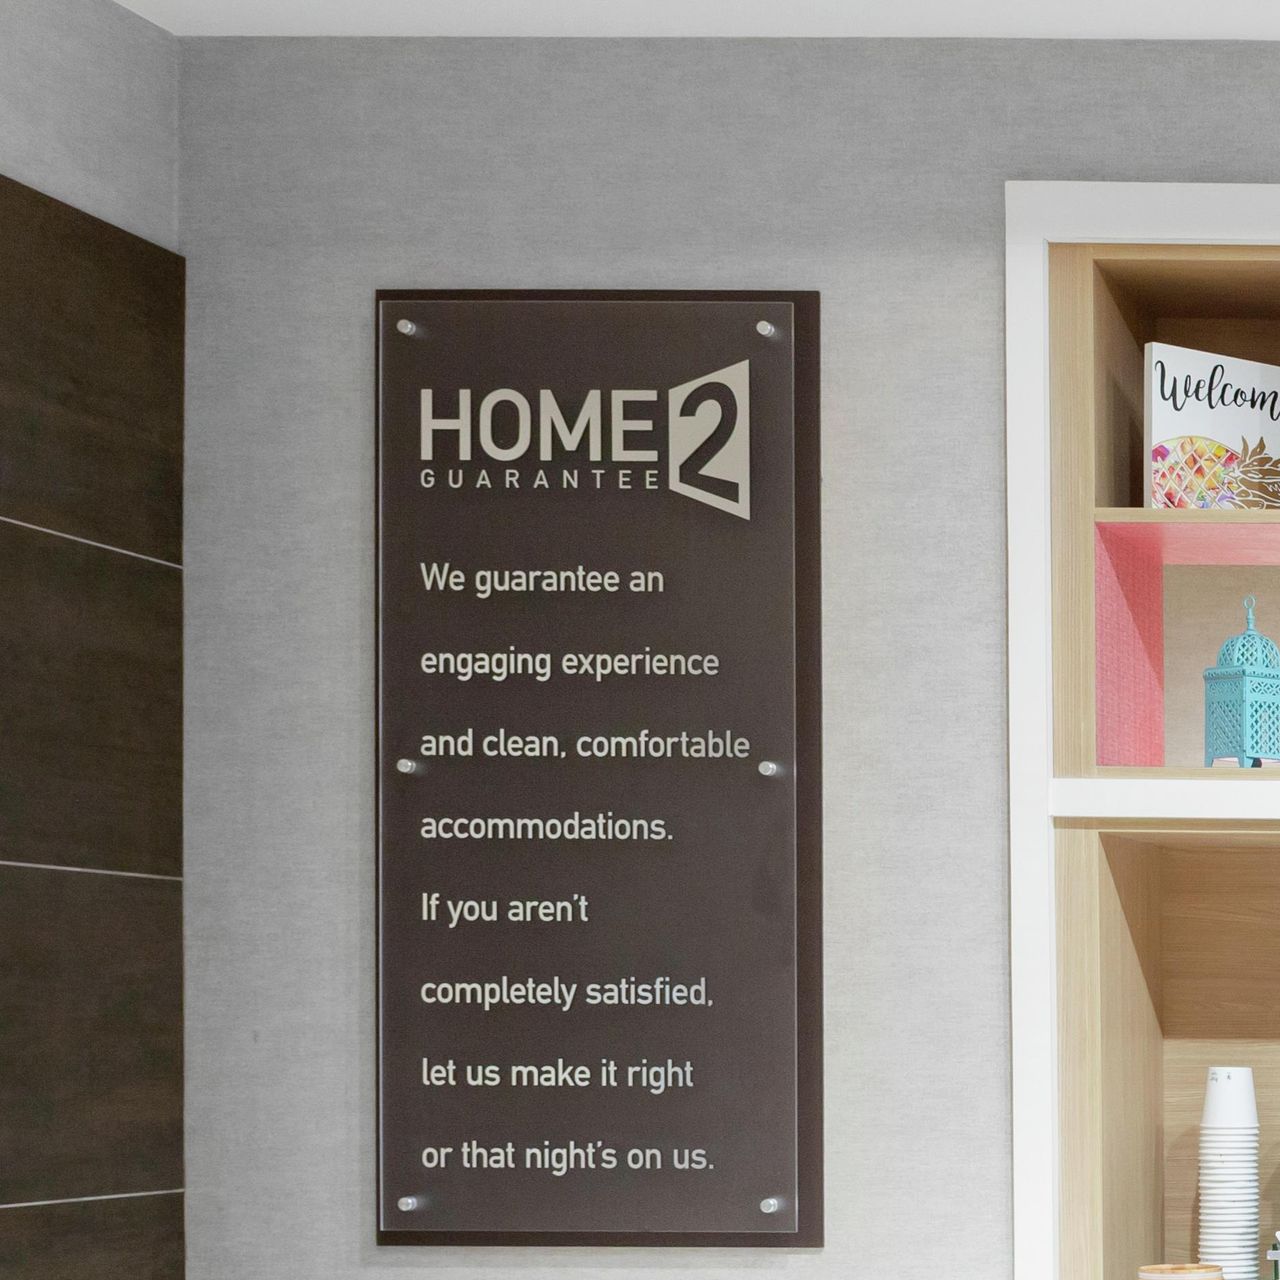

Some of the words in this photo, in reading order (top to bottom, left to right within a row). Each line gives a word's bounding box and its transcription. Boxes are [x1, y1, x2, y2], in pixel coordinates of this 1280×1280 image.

[420, 469, 659, 489] GUARANTEE
[420, 562, 465, 591] We
[475, 565, 620, 599] guarantee
[629, 571, 665, 592] an
[421, 646, 551, 682] engaging
[561, 646, 719, 682] experience
[420, 728, 473, 757] and
[482, 728, 567, 760] clean,
[576, 729, 750, 758] comfortable
[420, 811, 673, 840] accommodations.
[421, 892, 440, 921] If
[447, 900, 498, 928] you
[507, 893, 589, 922] aren't
[420, 976, 577, 1011] completely
[585, 976, 713, 1007] satisfied,
[422, 1058, 456, 1086] let
[466, 1065, 500, 1087] us
[511, 1058, 591, 1087] make
[601, 1058, 618, 1087] it
[627, 1058, 694, 1094] right
[421, 1147, 454, 1168] or
[461, 1140, 516, 1169] that
[525, 1140, 618, 1176] night's
[627, 1148, 662, 1170] on
[673, 1148, 715, 1170] us.
